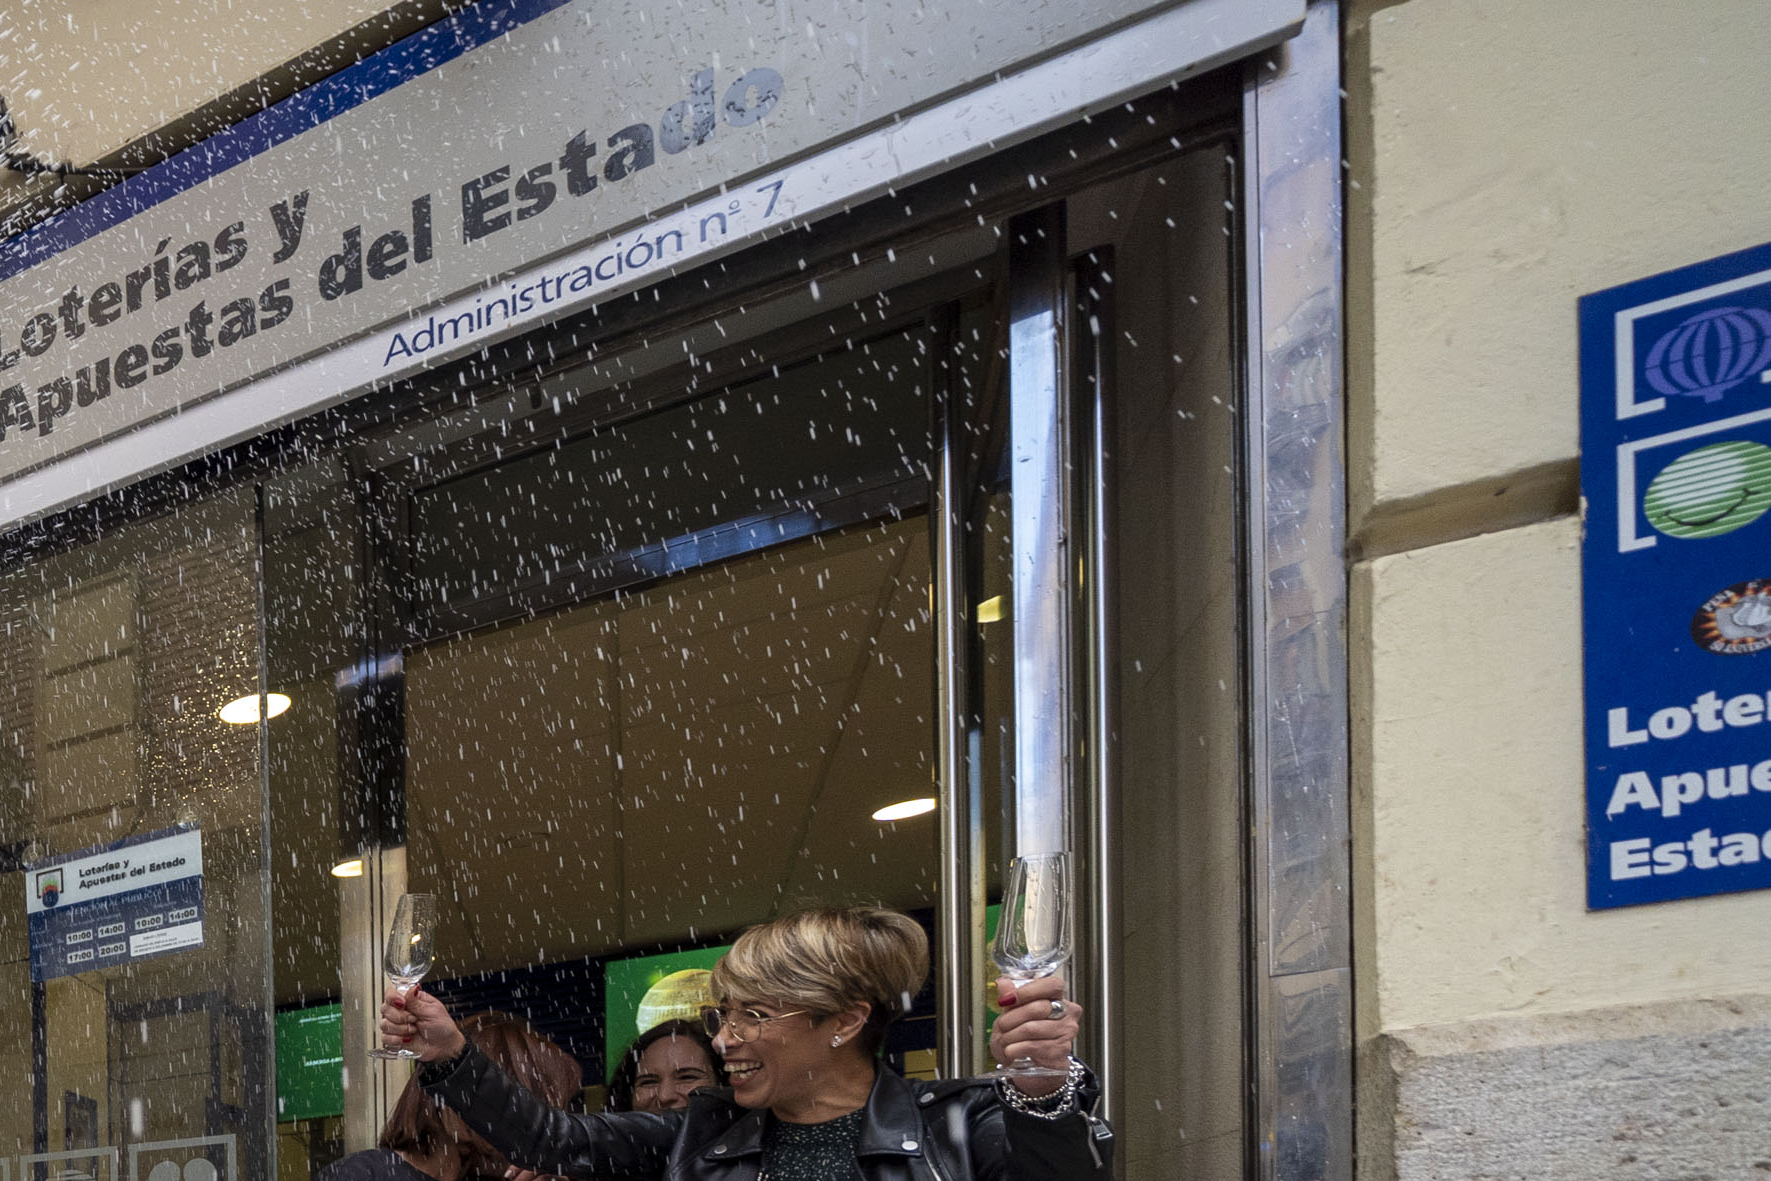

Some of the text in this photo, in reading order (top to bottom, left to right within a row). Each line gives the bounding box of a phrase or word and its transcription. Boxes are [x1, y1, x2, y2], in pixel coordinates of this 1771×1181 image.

[317, 195, 431, 302] del
[460, 66, 785, 244] Estado
[271, 189, 311, 266] y
[382, 223, 683, 367] Administración
[759, 179, 786, 220] 7
[79, 859, 130, 878] Loterías y
[79, 857, 186, 889] Apuestas del Estado
[136, 917, 162, 929] 10:00
[169, 909, 196, 922] 14:00
[67, 924, 124, 943] 10:00 14:00
[68, 952, 92, 963] 17:00
[100, 944, 125, 956] 20:00
